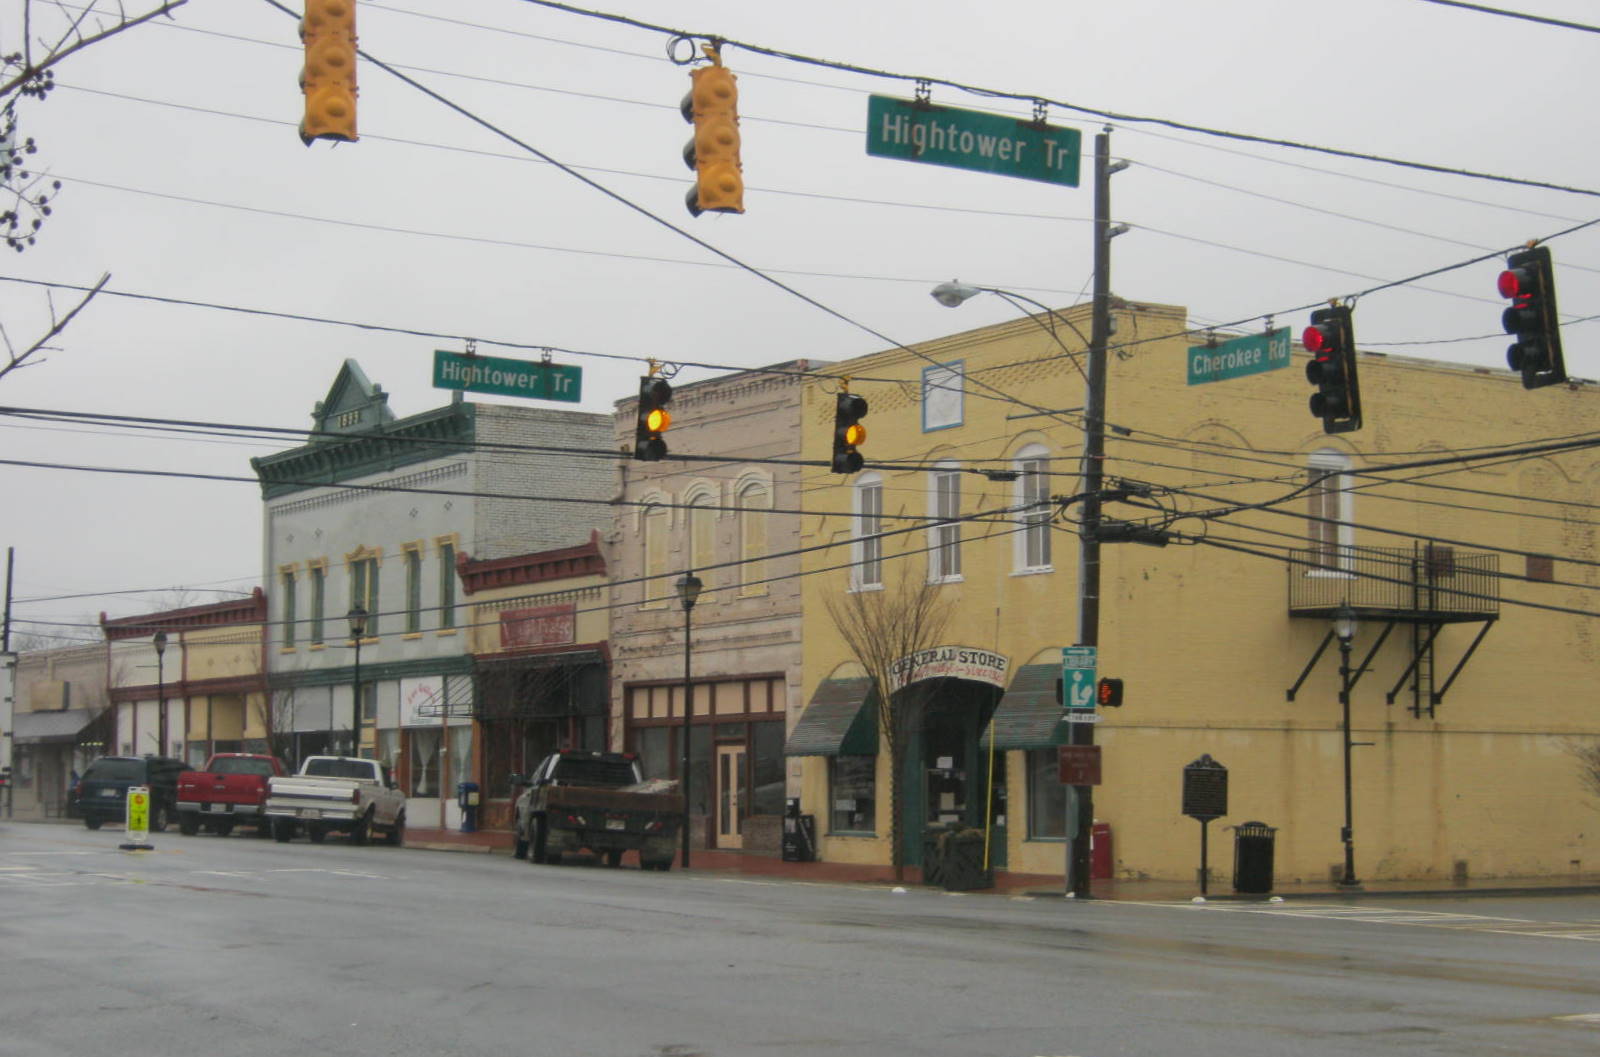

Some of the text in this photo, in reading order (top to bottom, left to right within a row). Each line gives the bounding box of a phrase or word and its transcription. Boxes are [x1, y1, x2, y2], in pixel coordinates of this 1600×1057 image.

[881, 112, 1069, 170] Hightower Tr
[1193, 338, 1287, 375] Cherokee Rd
[441, 360, 573, 393] Hightower Tr
[892, 648, 956, 675] GENERAL
[959, 650, 1006, 671] STORE
